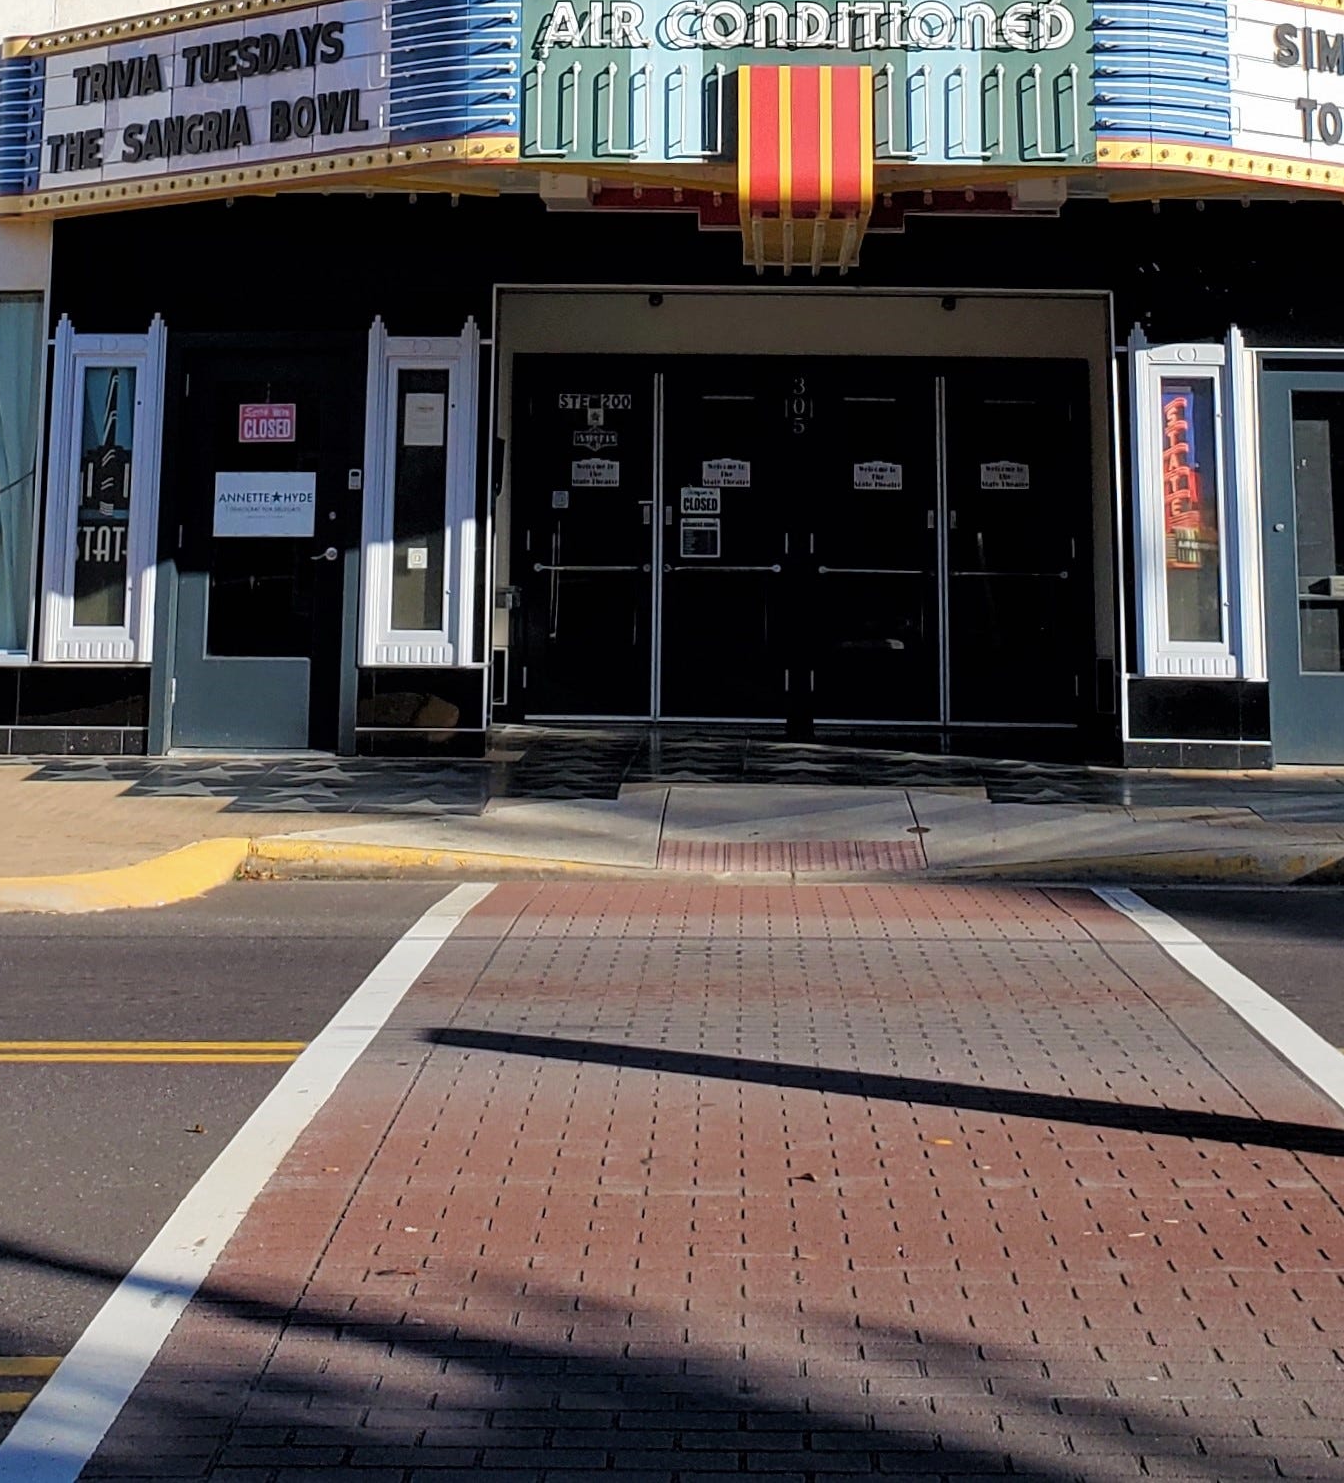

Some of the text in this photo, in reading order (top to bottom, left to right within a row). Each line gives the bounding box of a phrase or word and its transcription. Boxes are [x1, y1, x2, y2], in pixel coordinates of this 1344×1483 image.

[544, 0, 1077, 50] AIR CONDITIONED
[73, 21, 344, 106] TRIVIA TUESDAYS
[47, 89, 369, 174] THE SANGRIA BOWL
[1295, 97, 1343, 145] TO
[560, 394, 631, 409] STE 200
[244, 419, 291, 438] CLOSED
[218, 492, 313, 503] ANNETTE HYDE
[683, 497, 718, 511] CLOSED
